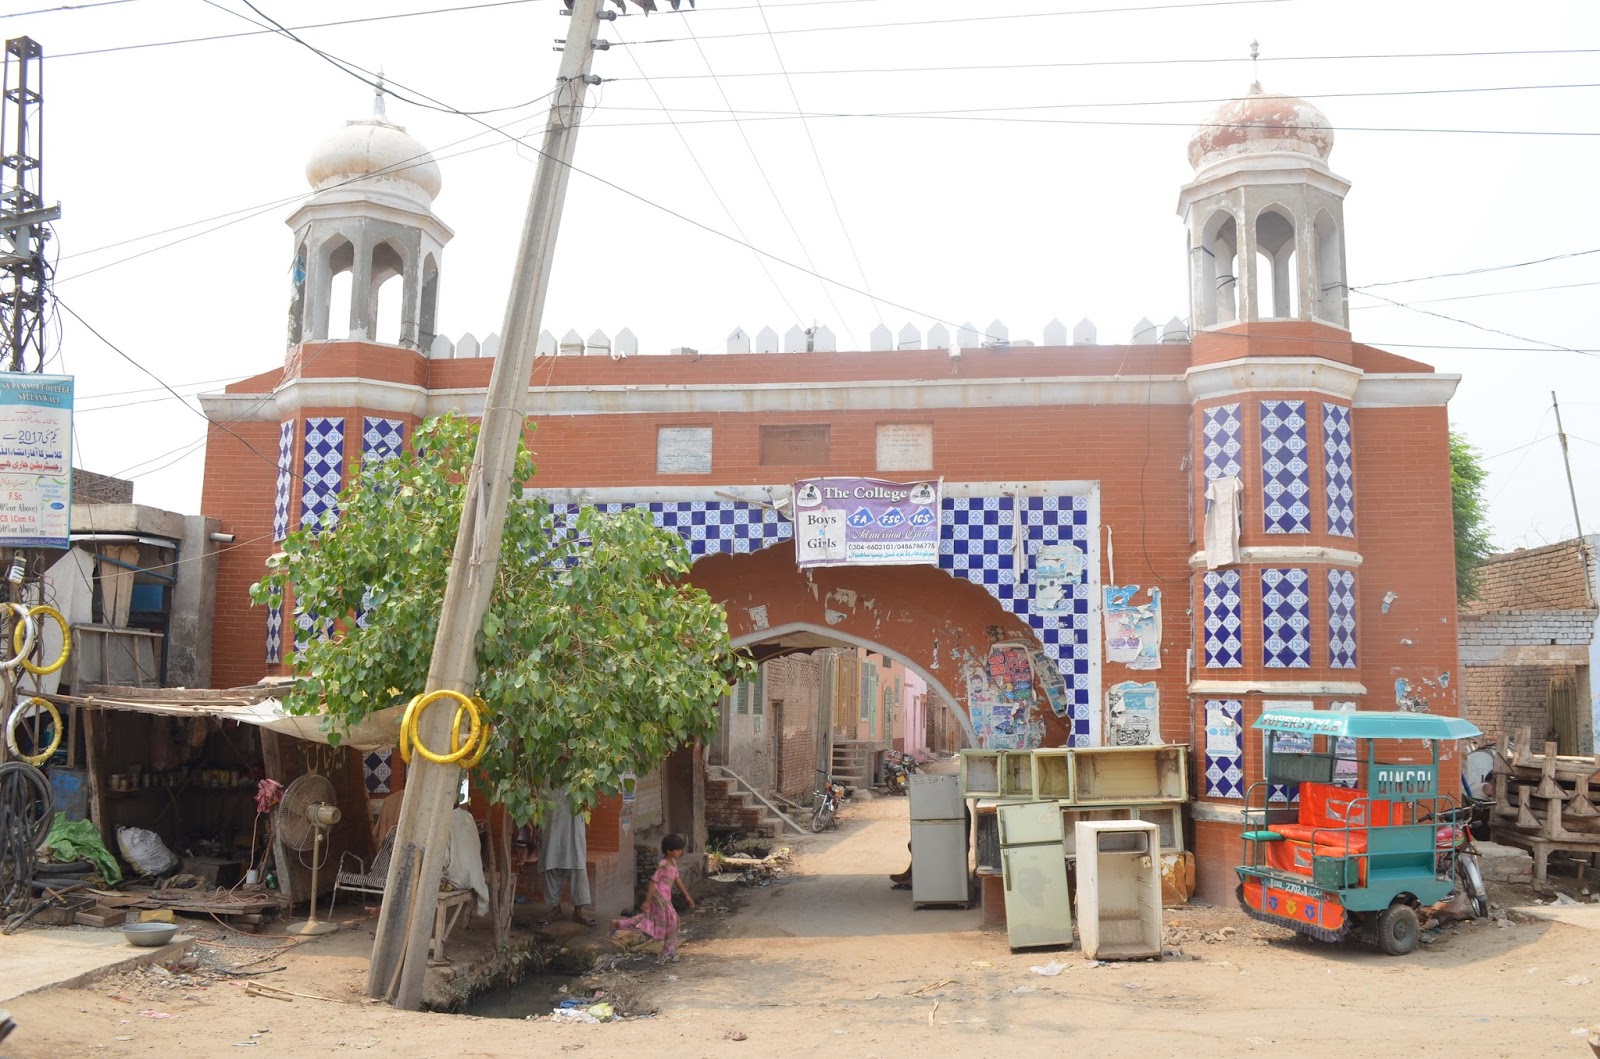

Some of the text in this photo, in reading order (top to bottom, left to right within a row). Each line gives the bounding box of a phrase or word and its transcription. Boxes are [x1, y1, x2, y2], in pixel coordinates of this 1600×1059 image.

[2, 382, 71, 394] SUPERIOR COLLEGE
[9, 491, 23, 501] F.Sc
[823, 486, 908, 502] The College
[807, 514, 837, 528] Boys
[853, 515, 867, 524] FA
[882, 515, 901, 524] FSC
[912, 514, 931, 524] ICS
[851, 529, 902, 539] Admission
[904, 526, 930, 540] Open
[807, 538, 837, 549] Girls
[1378, 771, 1433, 794] QINGQI
